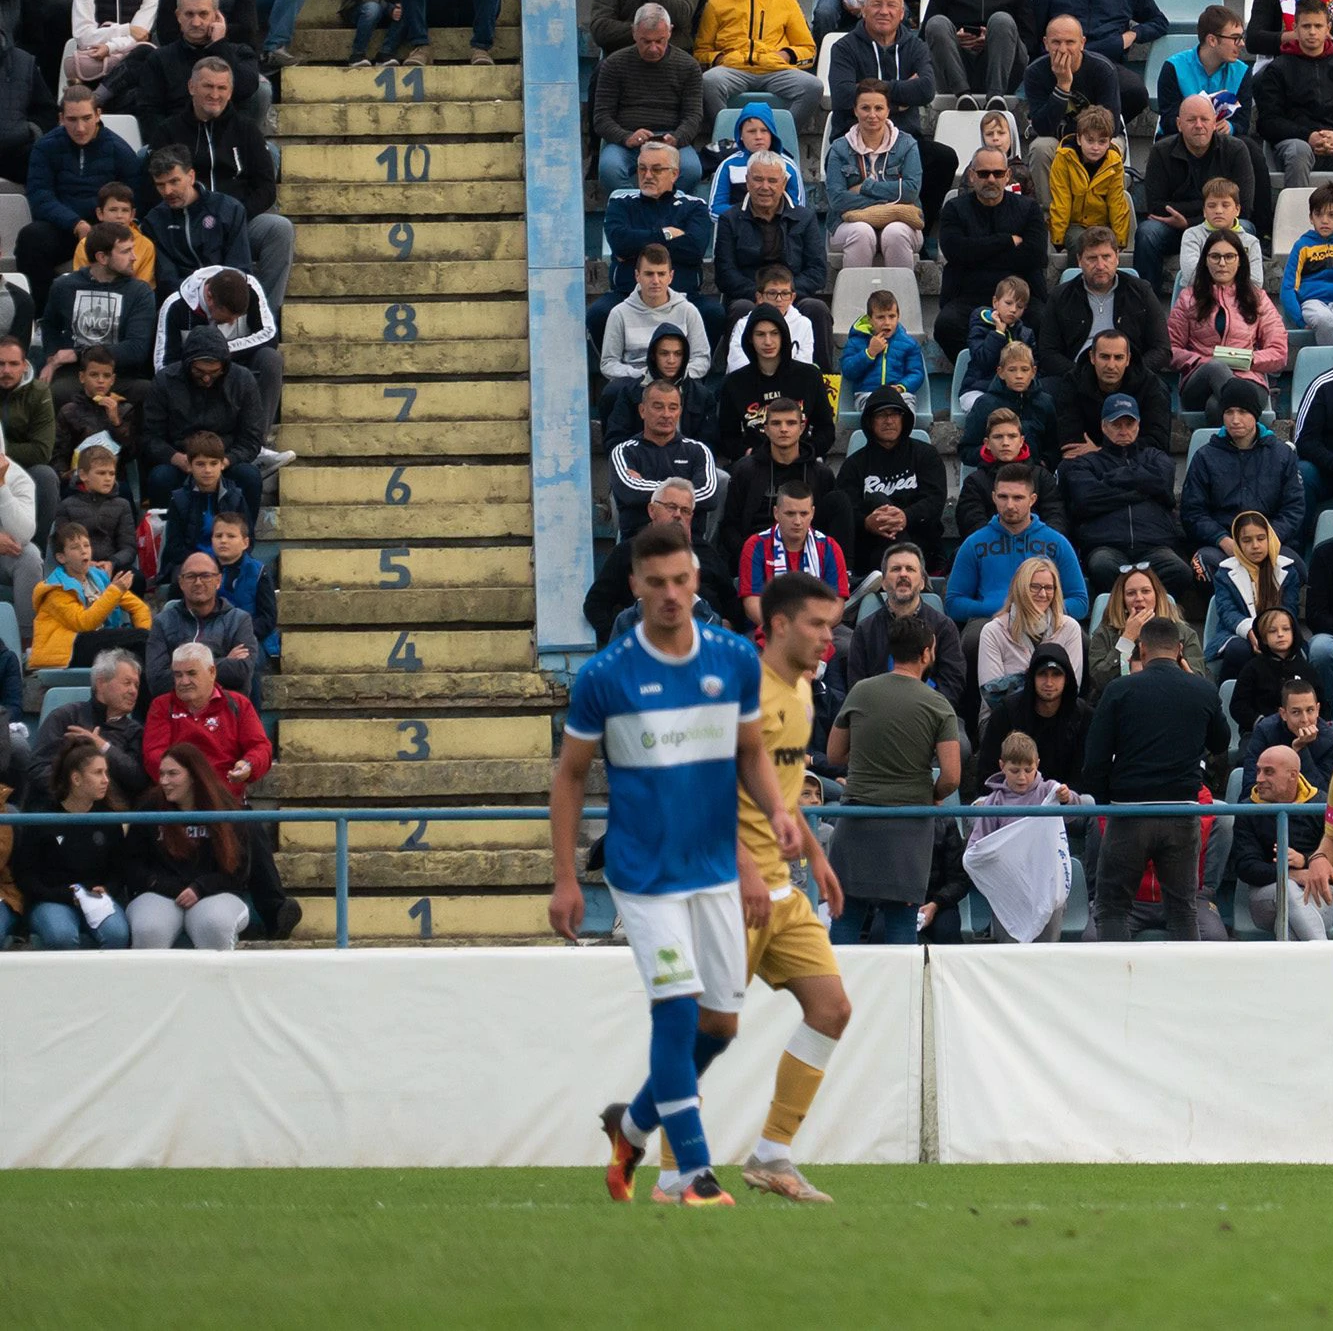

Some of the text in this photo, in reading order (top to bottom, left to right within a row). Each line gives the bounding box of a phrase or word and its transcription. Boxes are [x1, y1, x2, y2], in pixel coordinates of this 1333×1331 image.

[374, 68, 425, 102] 11
[376, 144, 430, 183] 10
[388, 222, 414, 261] 9
[83, 315, 111, 330] NYC
[384, 302, 418, 343] 8
[383, 387, 418, 423] 7
[385, 466, 412, 506] 6
[379, 546, 412, 590] 5
[387, 631, 424, 673] 4
[396, 720, 431, 761] 3
[408, 897, 433, 939] 1
